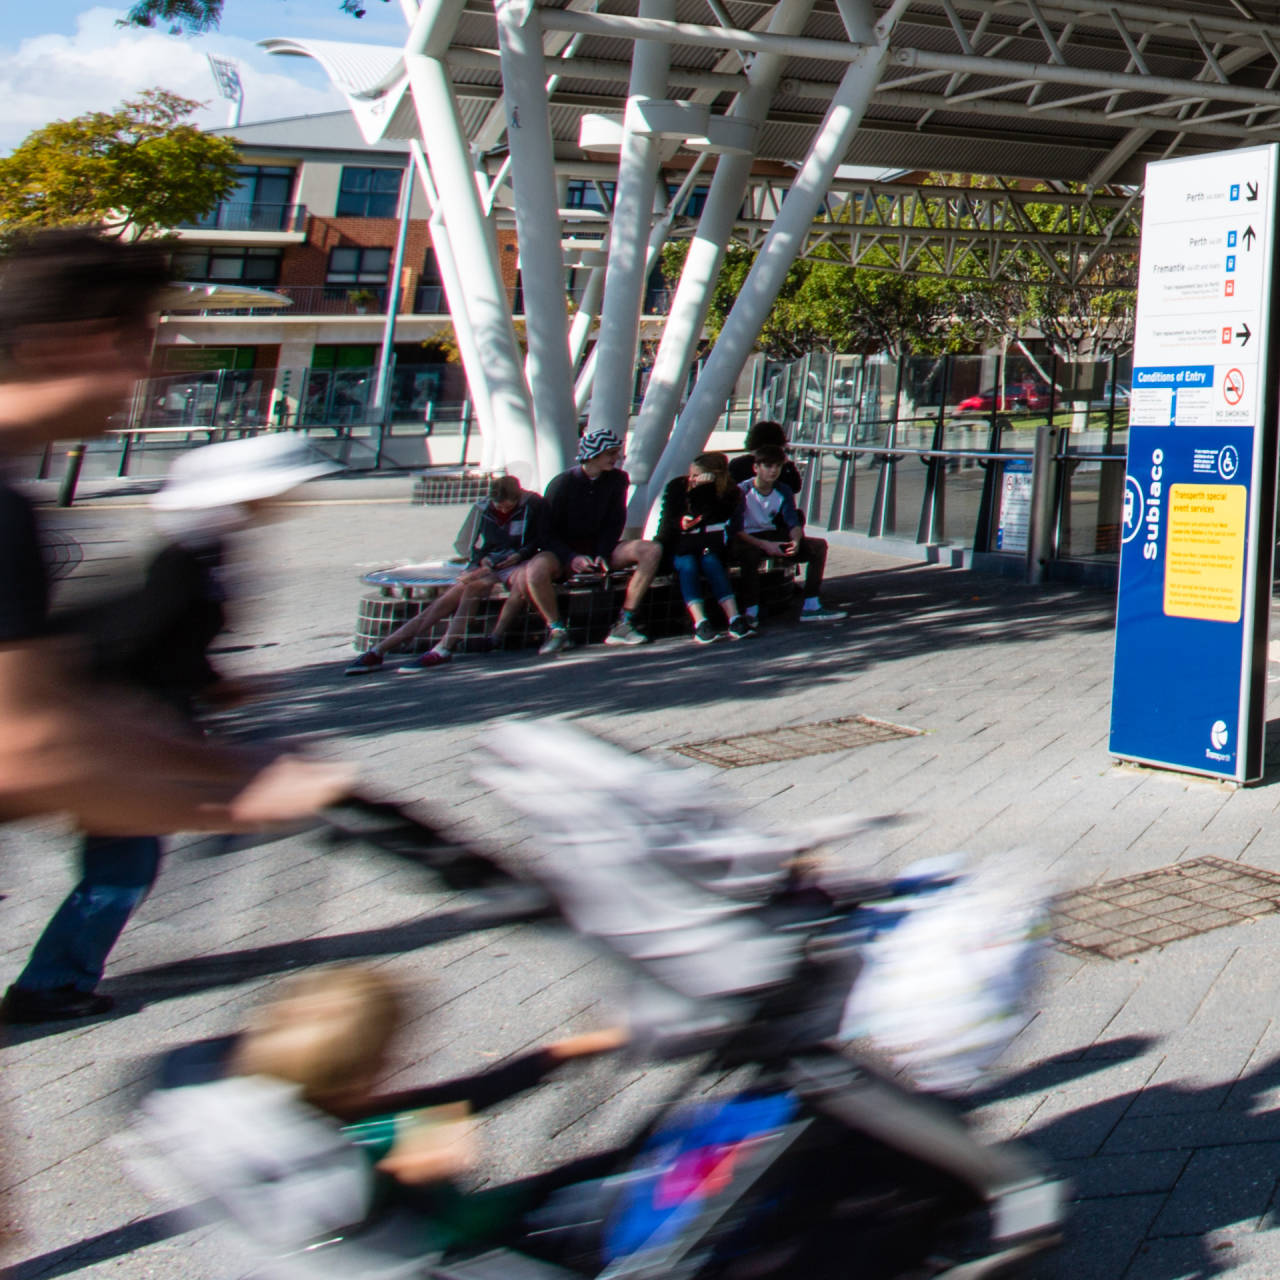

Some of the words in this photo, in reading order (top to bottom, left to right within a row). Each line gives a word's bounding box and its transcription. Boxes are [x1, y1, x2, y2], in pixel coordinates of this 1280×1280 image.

[1185, 192, 1205, 202] Perth
[1189, 237, 1208, 247] Perth
[1153, 264, 1185, 273] Fremantle
[1137, 371, 1175, 383] Conditions
[1176, 370, 1184, 382] of
[1185, 370, 1206, 384] Entry
[1175, 490, 1206, 501] Transperth
[1206, 491, 1227, 502] special
[1143, 448, 1164, 561] Subiaco
[1173, 504, 1190, 513] event
[1190, 505, 1215, 514] services
